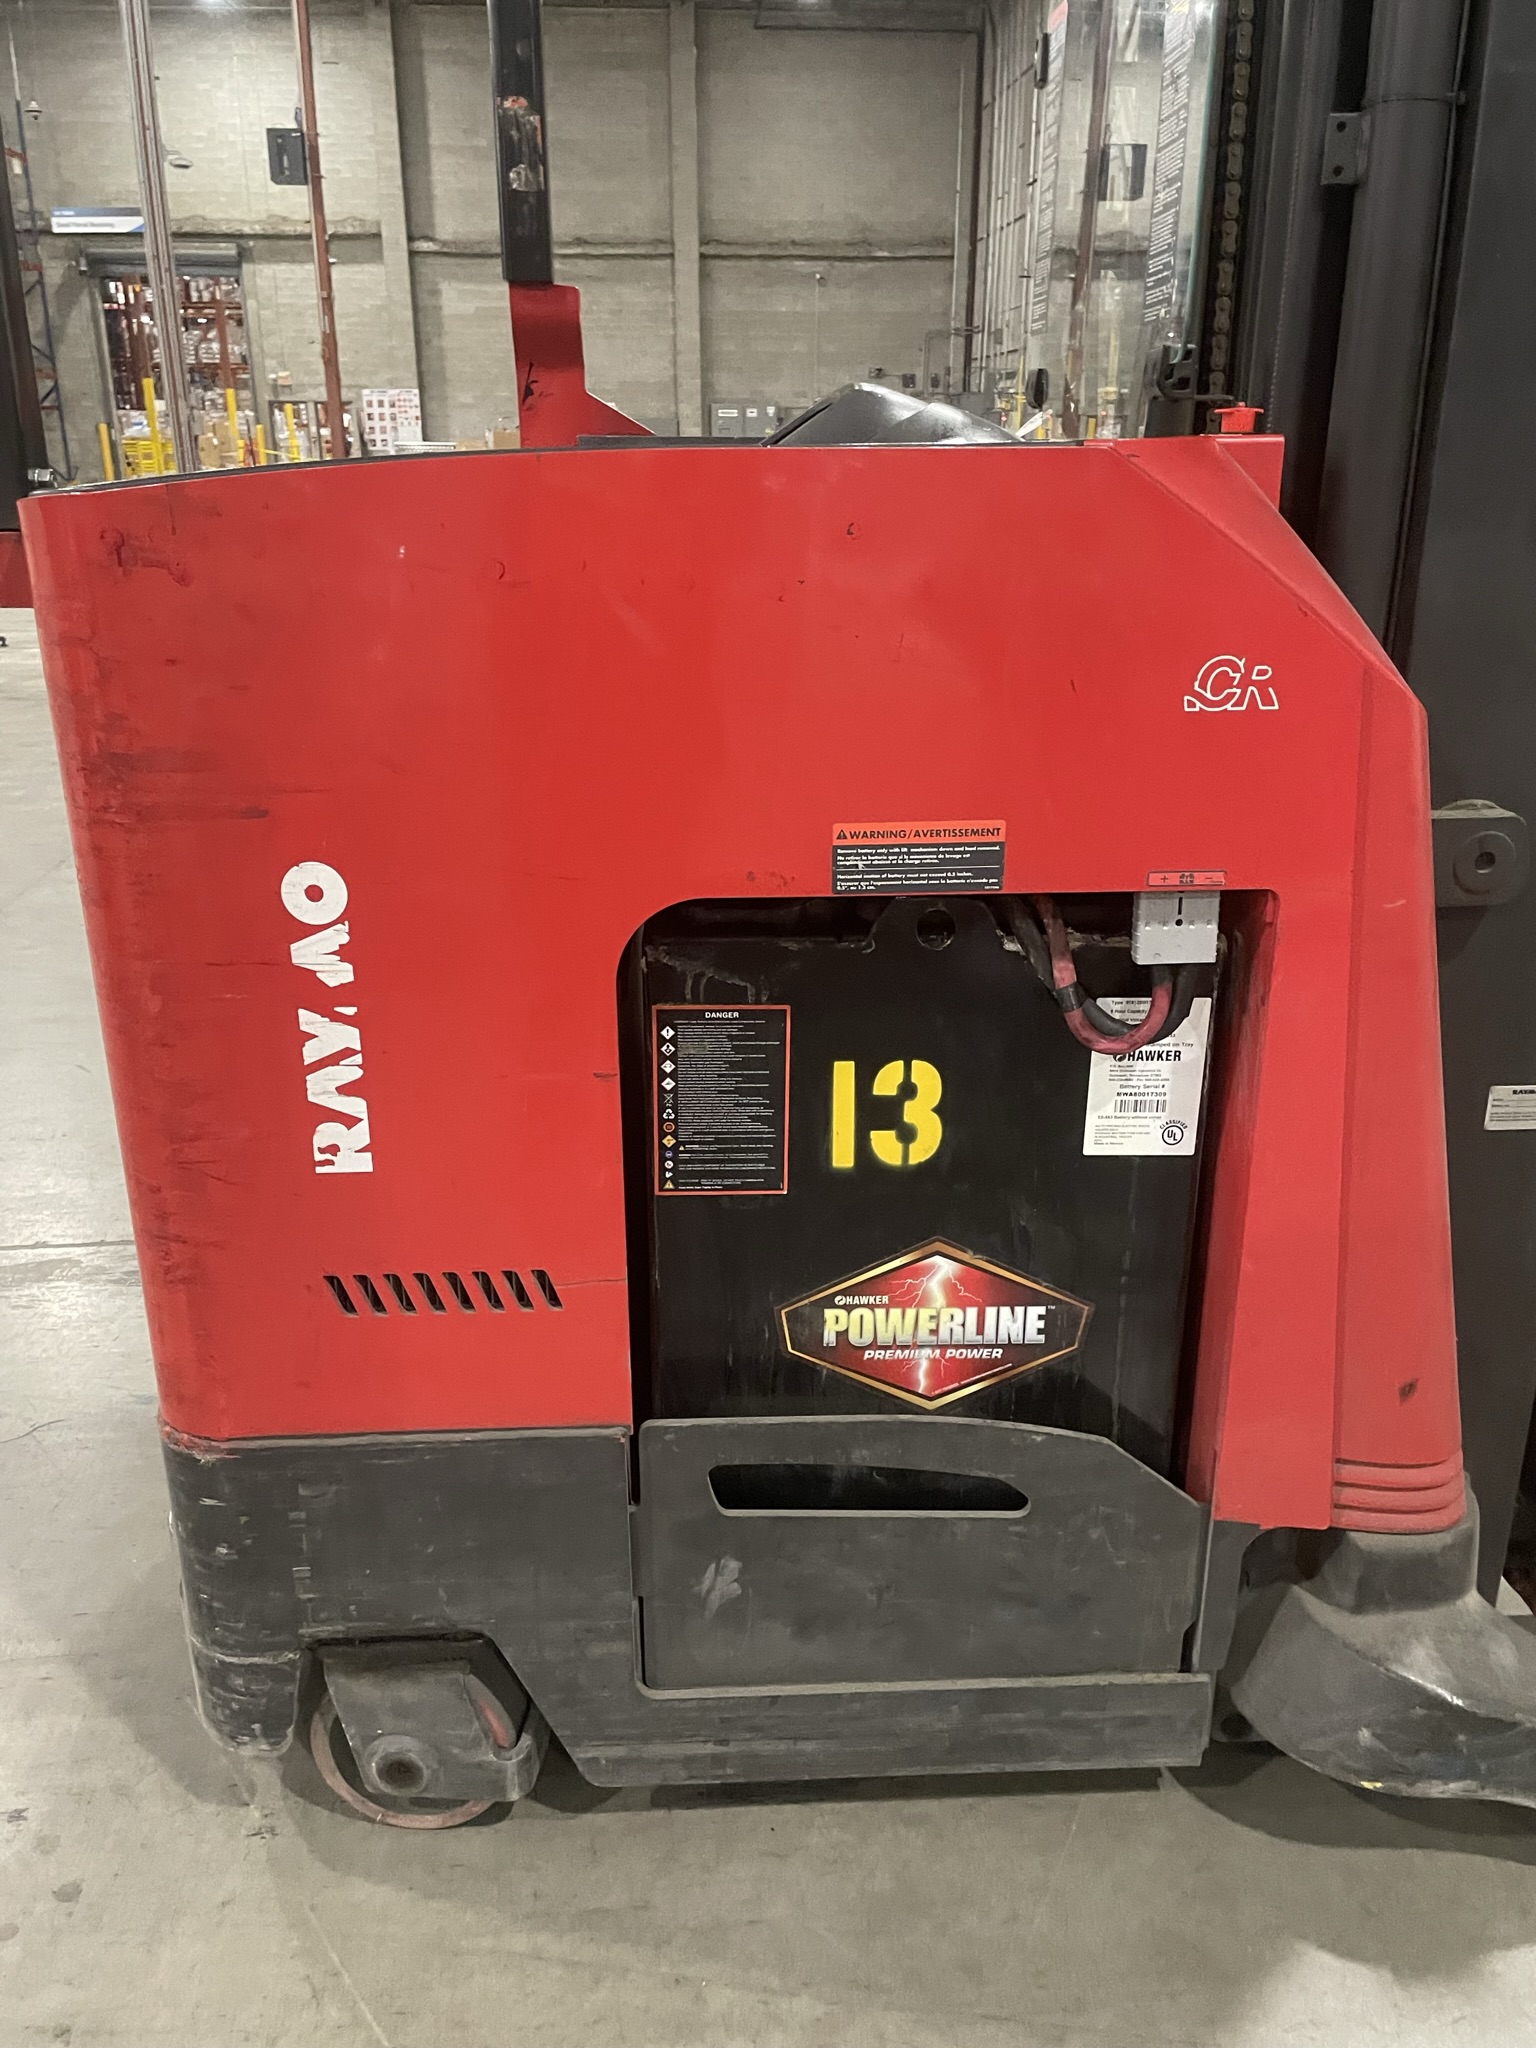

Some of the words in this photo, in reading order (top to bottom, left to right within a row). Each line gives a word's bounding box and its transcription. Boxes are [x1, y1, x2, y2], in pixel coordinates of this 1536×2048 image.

[849, 828, 1001, 839] WARNING/AVERTISSEMENT
[1127, 1050, 1182, 1061] HAWKER
[832, 1060, 942, 1167] 13
[1167, 1130, 1178, 1141] UL
[846, 1296, 889, 1305] HAWKER
[823, 1306, 1046, 1346] POWERLINE
[863, 1349, 940, 1360] PREMIUM
[945, 1348, 1004, 1359] POWER
